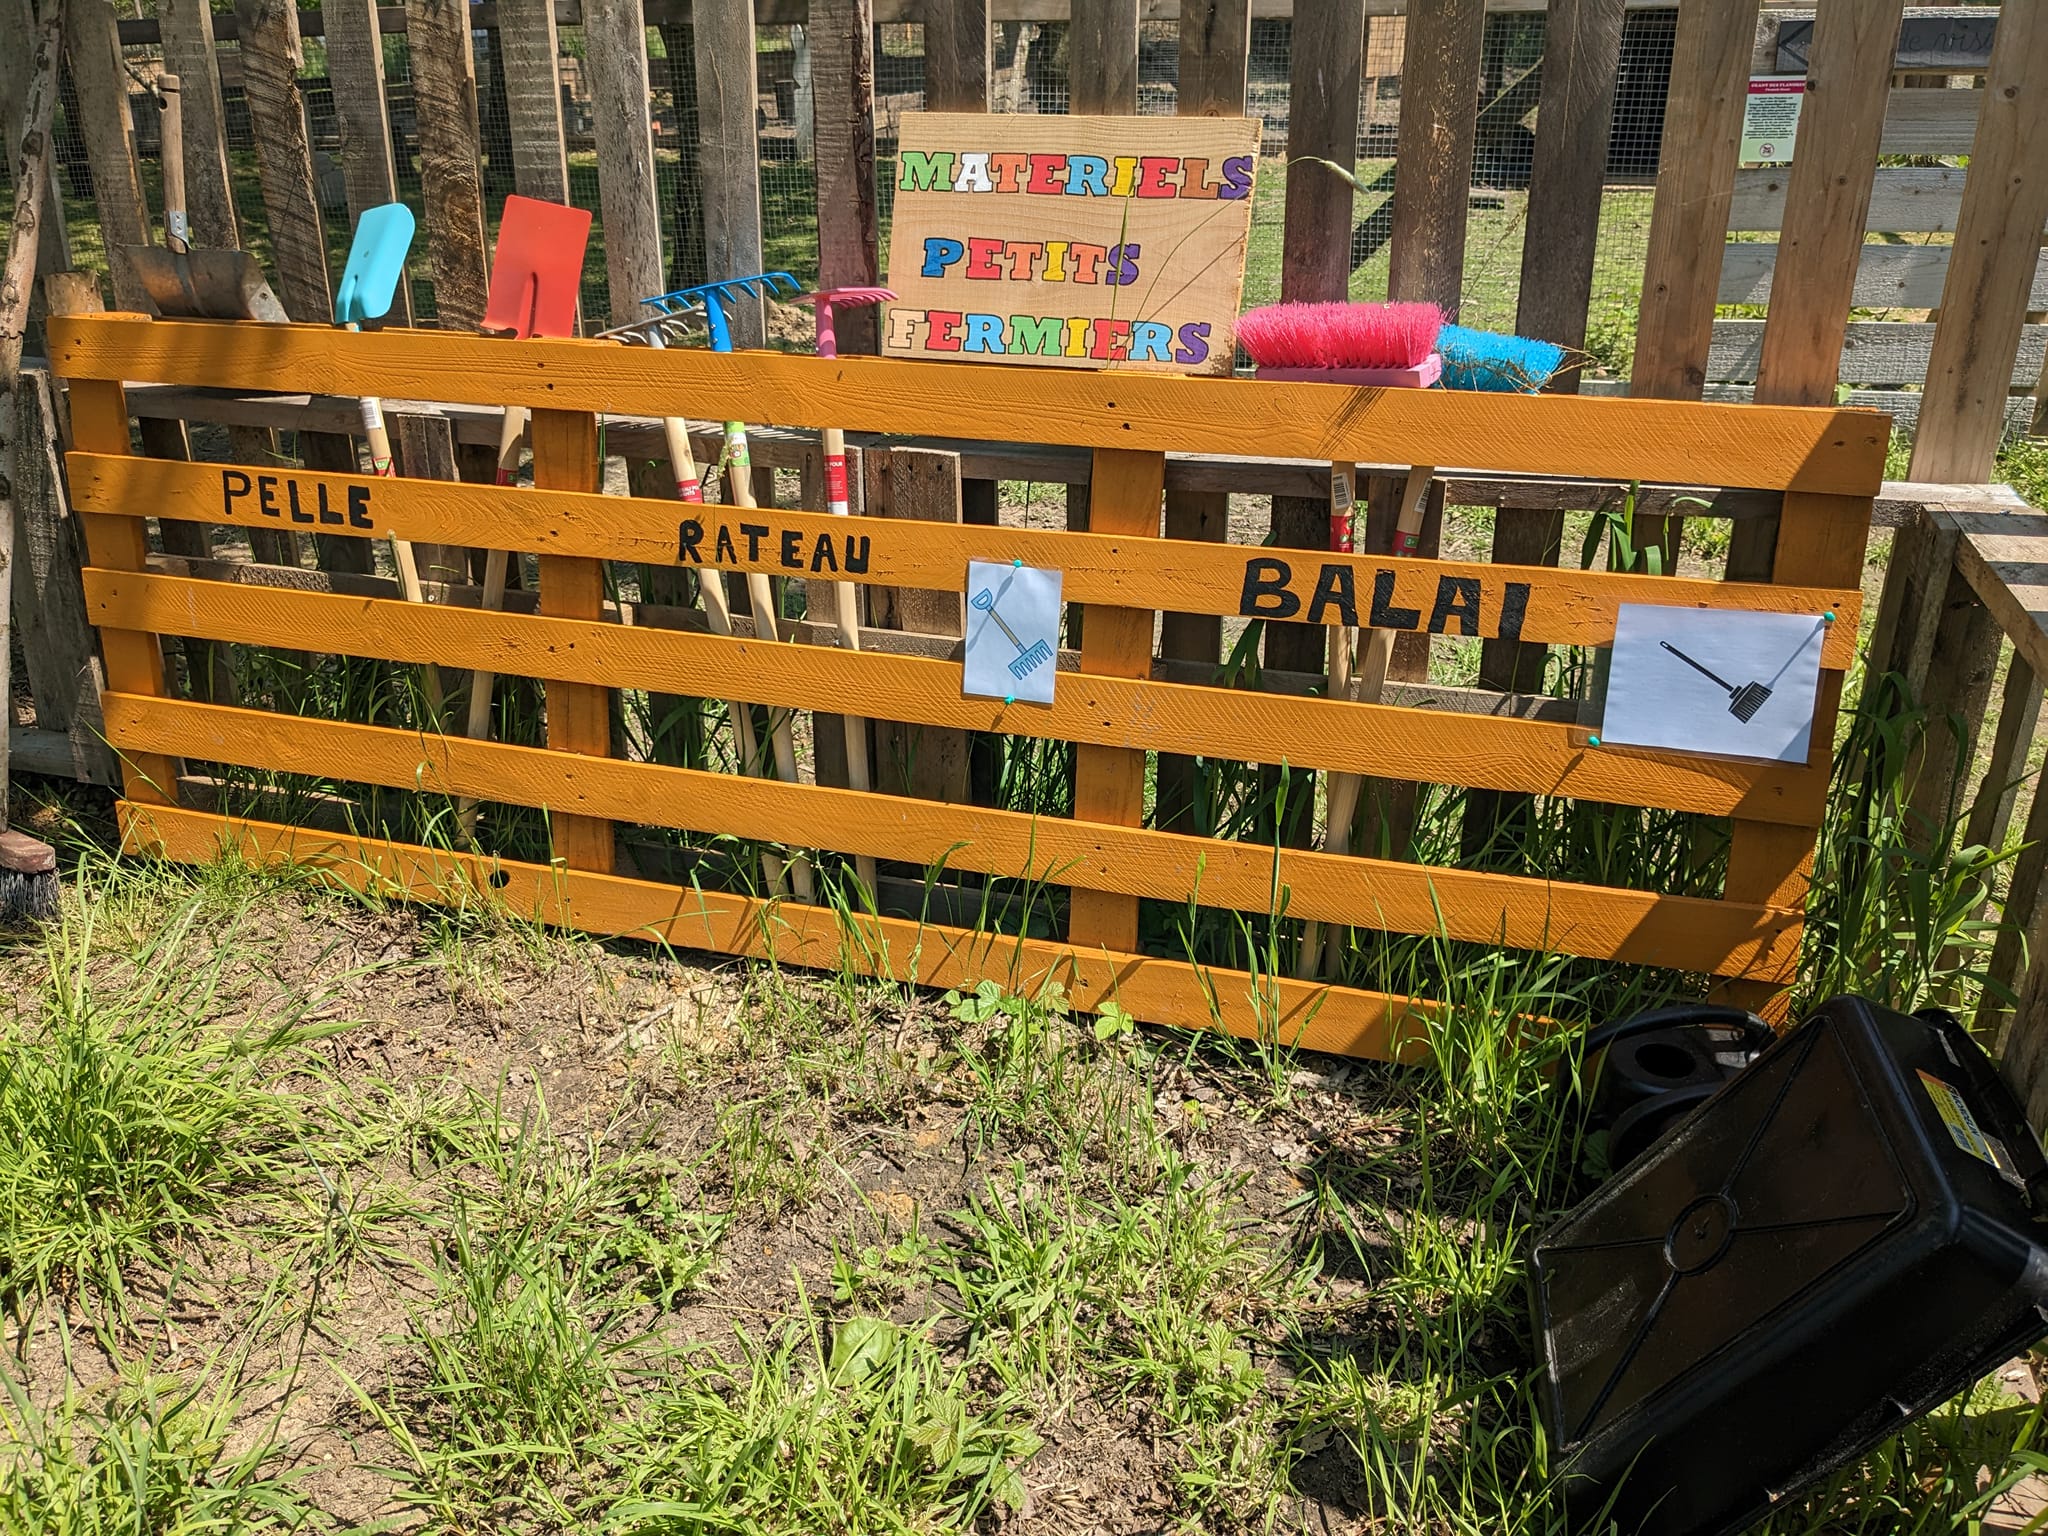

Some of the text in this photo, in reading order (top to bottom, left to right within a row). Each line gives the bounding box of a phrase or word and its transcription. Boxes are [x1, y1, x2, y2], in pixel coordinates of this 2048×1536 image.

[1933, 23, 1996, 53] visi
[899, 151, 1254, 200] MATERIELS
[921, 237, 1141, 286] PETITS
[888, 308, 1212, 364] FERMIERS
[222, 470, 374, 529] PELLE
[679, 520, 871, 574] RATEAU
[1239, 557, 1532, 640] BALAI
